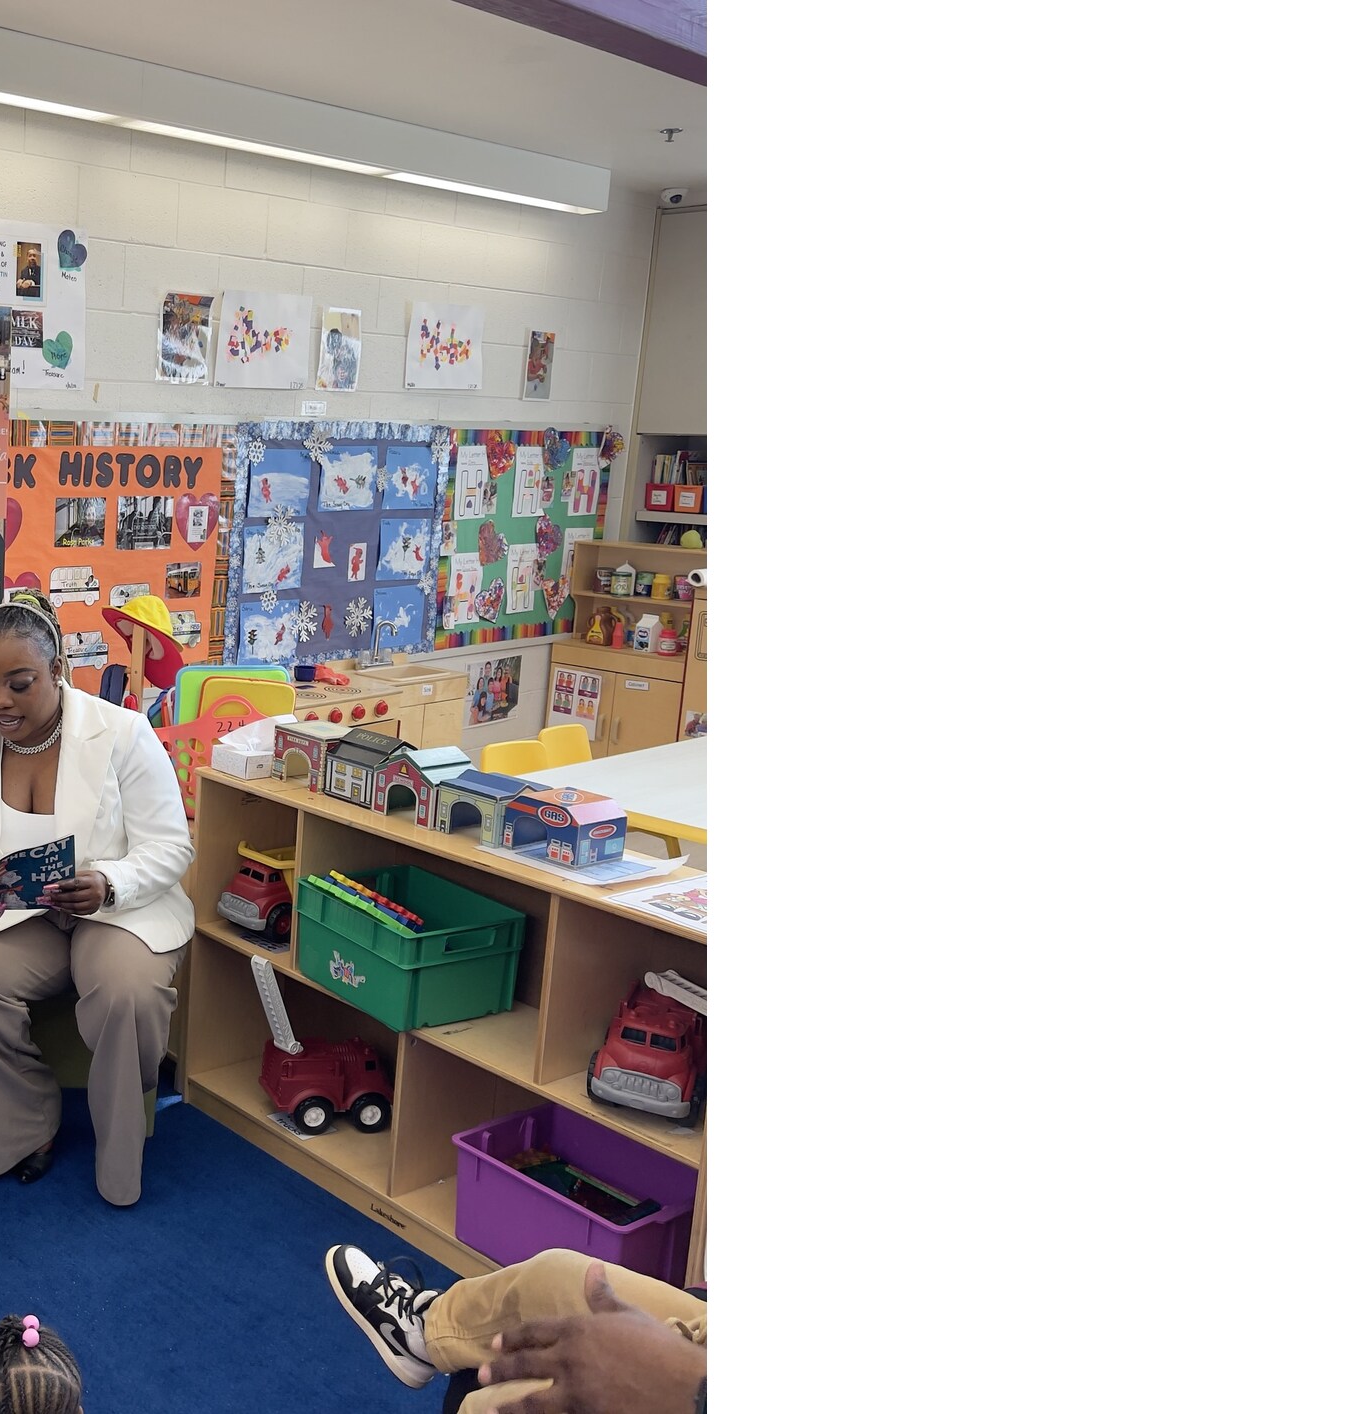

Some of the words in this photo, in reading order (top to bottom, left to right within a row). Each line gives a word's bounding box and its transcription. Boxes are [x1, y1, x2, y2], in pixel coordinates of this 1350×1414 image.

[11, 315, 38, 329] MLK
[14, 335, 36, 347] DAY
[7, 454, 37, 489] K
[58, 450, 203, 489] HISTORY
[76, 537, 95, 546] Parks
[61, 581, 78, 589] Truth
[356, 731, 390, 746] POLICE
[393, 775, 414, 787] SCHOOL
[544, 809, 566, 822] GAS
[5, 851, 27, 861] THE
[29, 837, 70, 859] CAT
[45, 854, 59, 864] IN
[39, 860, 64, 872] THE
[31, 864, 74, 882] HAT
